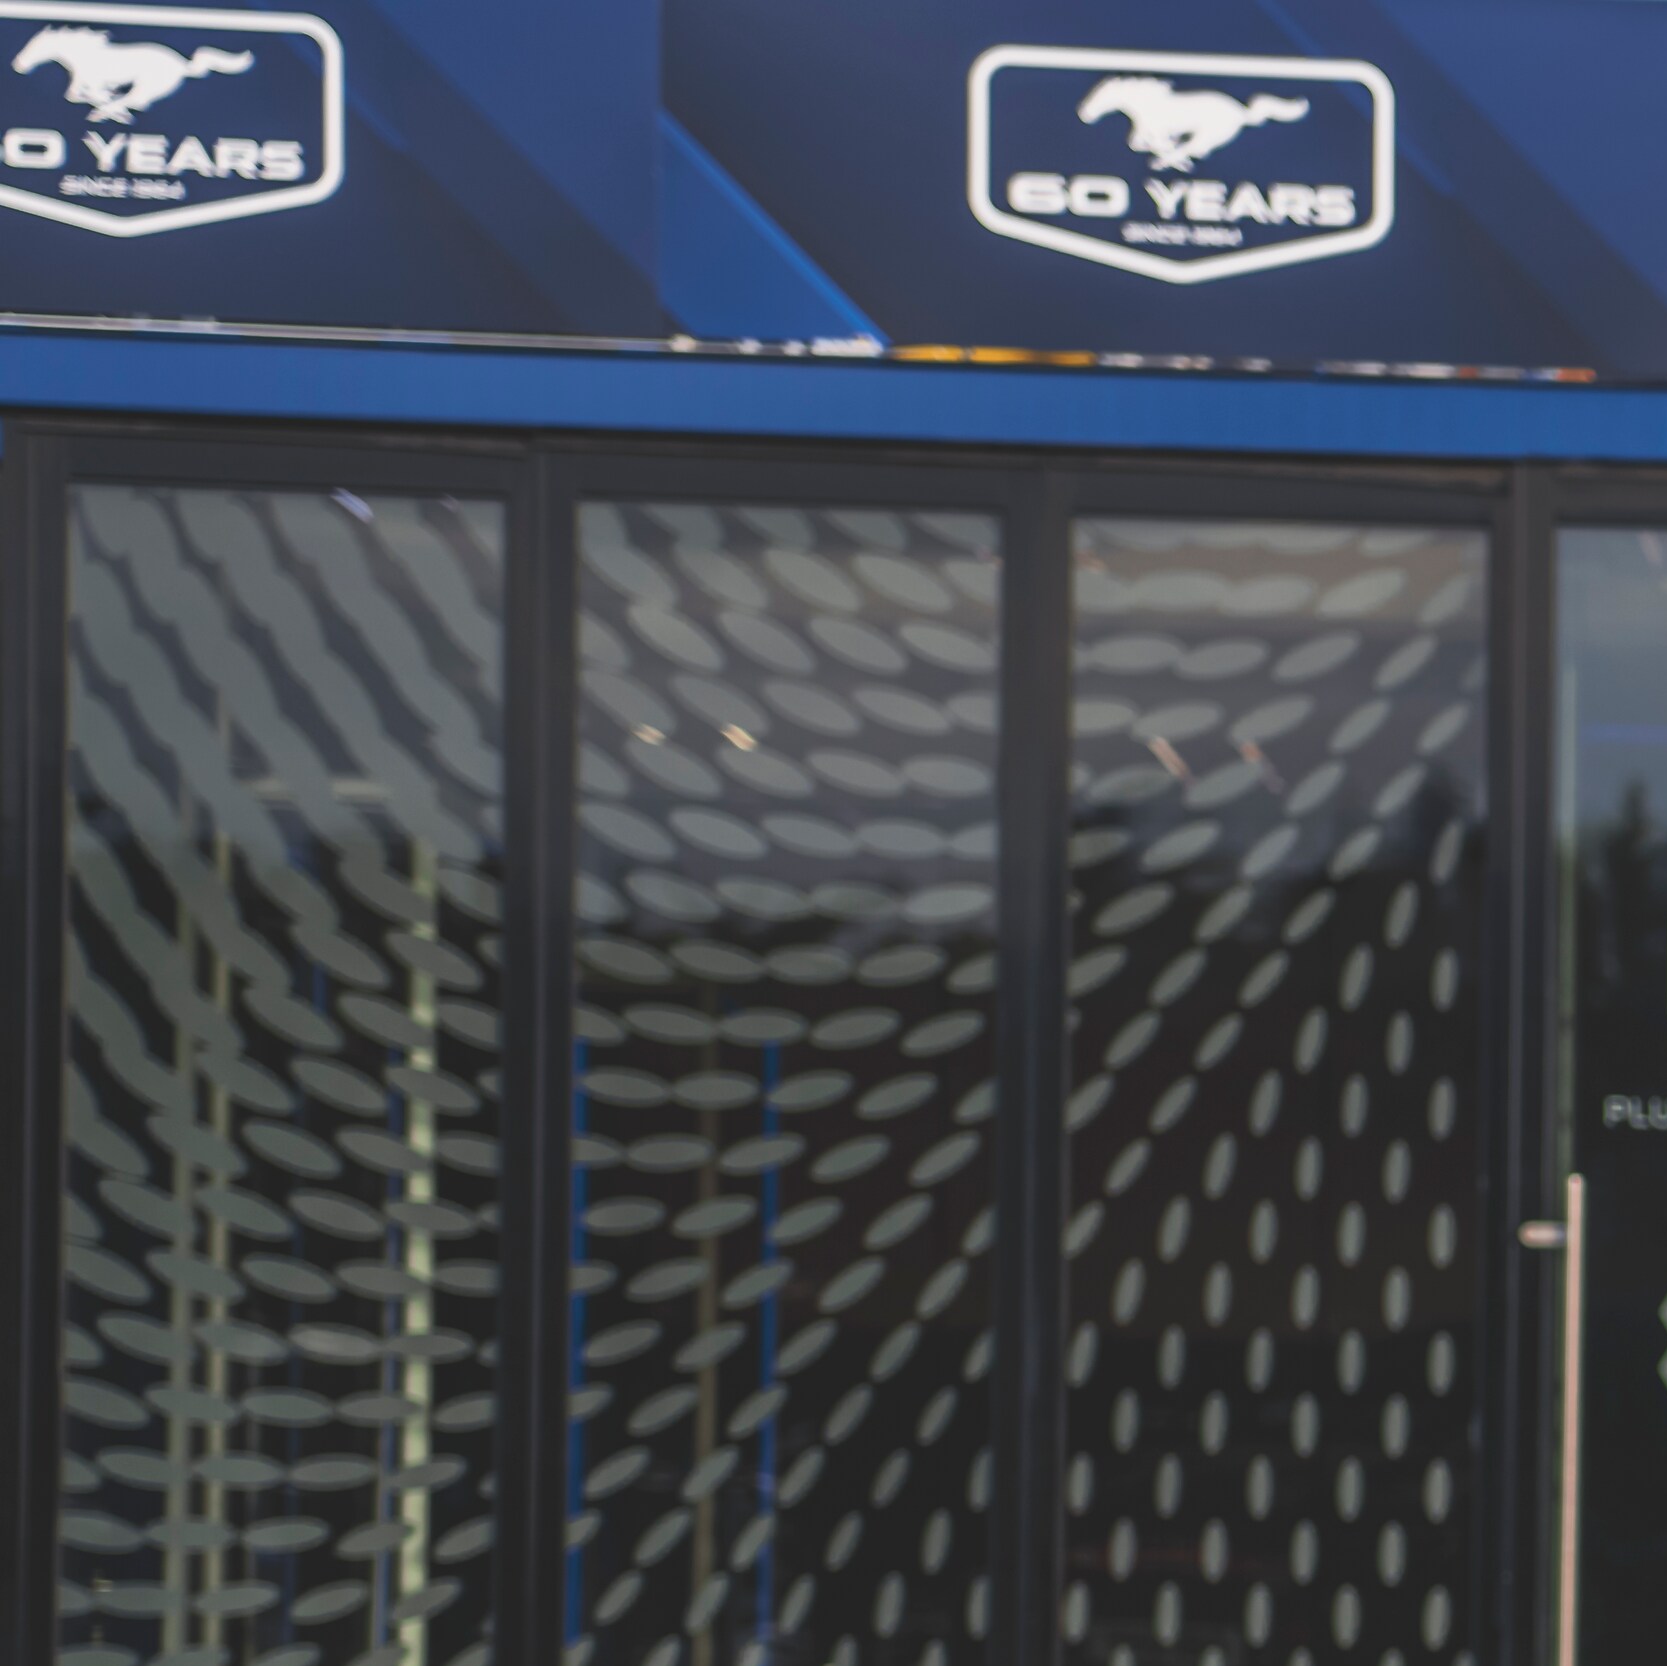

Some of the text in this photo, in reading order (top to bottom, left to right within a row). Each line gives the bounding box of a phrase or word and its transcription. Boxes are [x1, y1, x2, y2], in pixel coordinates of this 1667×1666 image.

[0, 129, 305, 181] 0 YEARS
[1008, 172, 1356, 226] 60 YEARS
